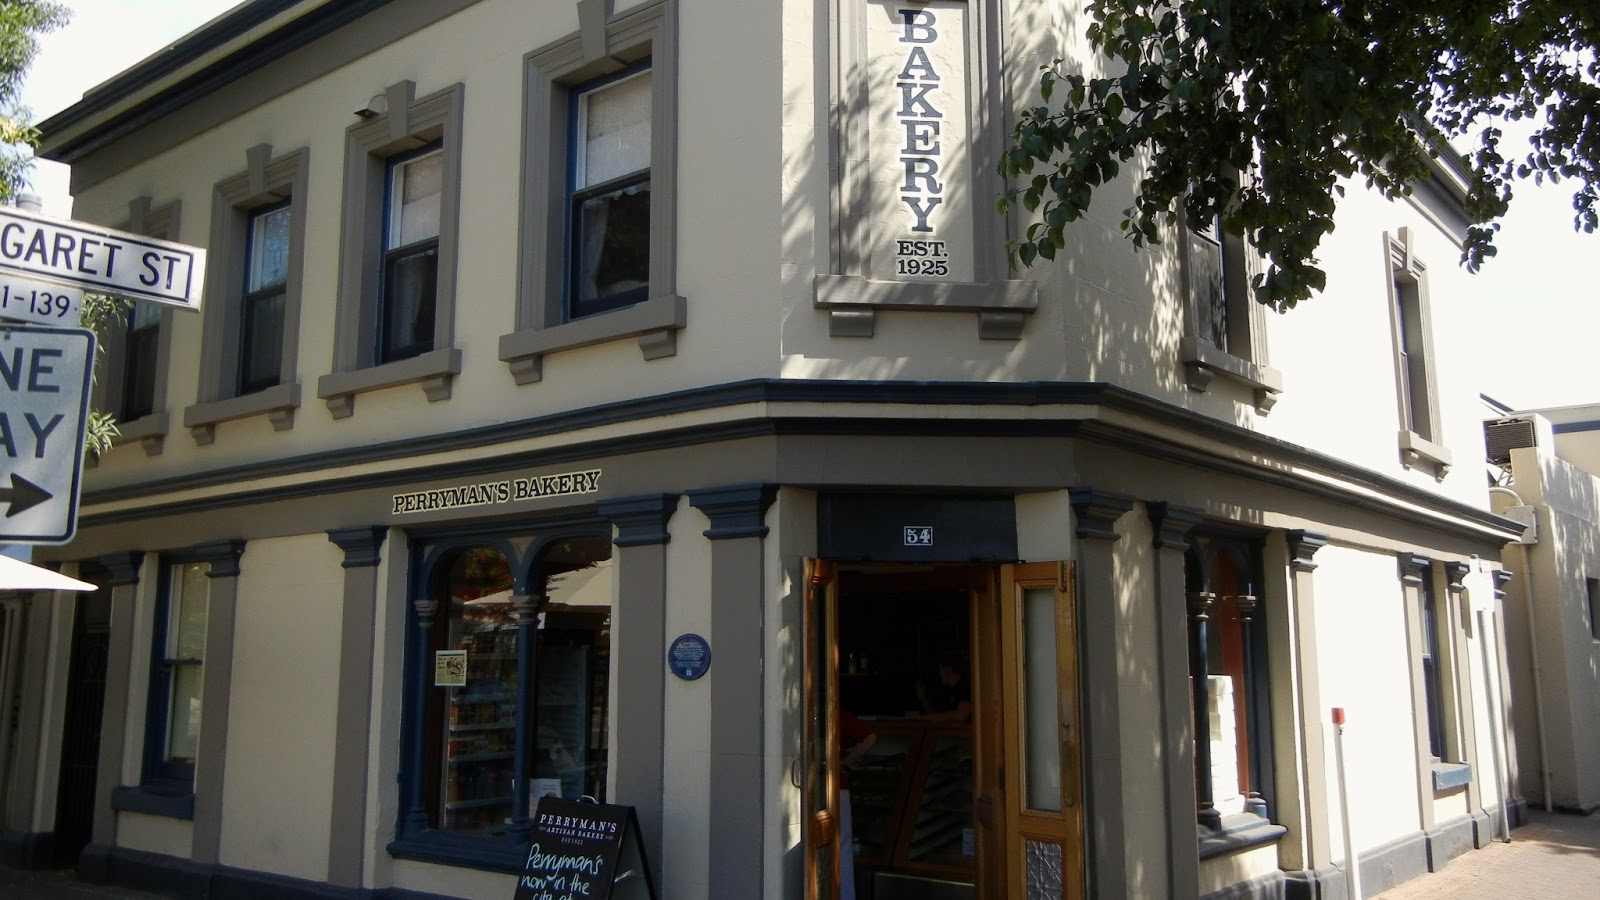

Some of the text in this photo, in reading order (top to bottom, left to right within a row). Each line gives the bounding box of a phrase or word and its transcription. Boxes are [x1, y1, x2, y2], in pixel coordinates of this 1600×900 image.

[897, 9, 943, 232] BAKERY
[1, 222, 181, 290] GARET ST
[897, 240, 948, 257] EST.
[897, 259, 948, 275] 1925
[2, 285, 71, 318] 1-139
[393, 470, 600, 513] PERRYMAN'S BAKERY
[906, 528, 931, 544] 54
[539, 813, 617, 833] PERRYMAN'S
[546, 826, 604, 840] ARTISAN BAKERY
[521, 873, 590, 895] now in the
